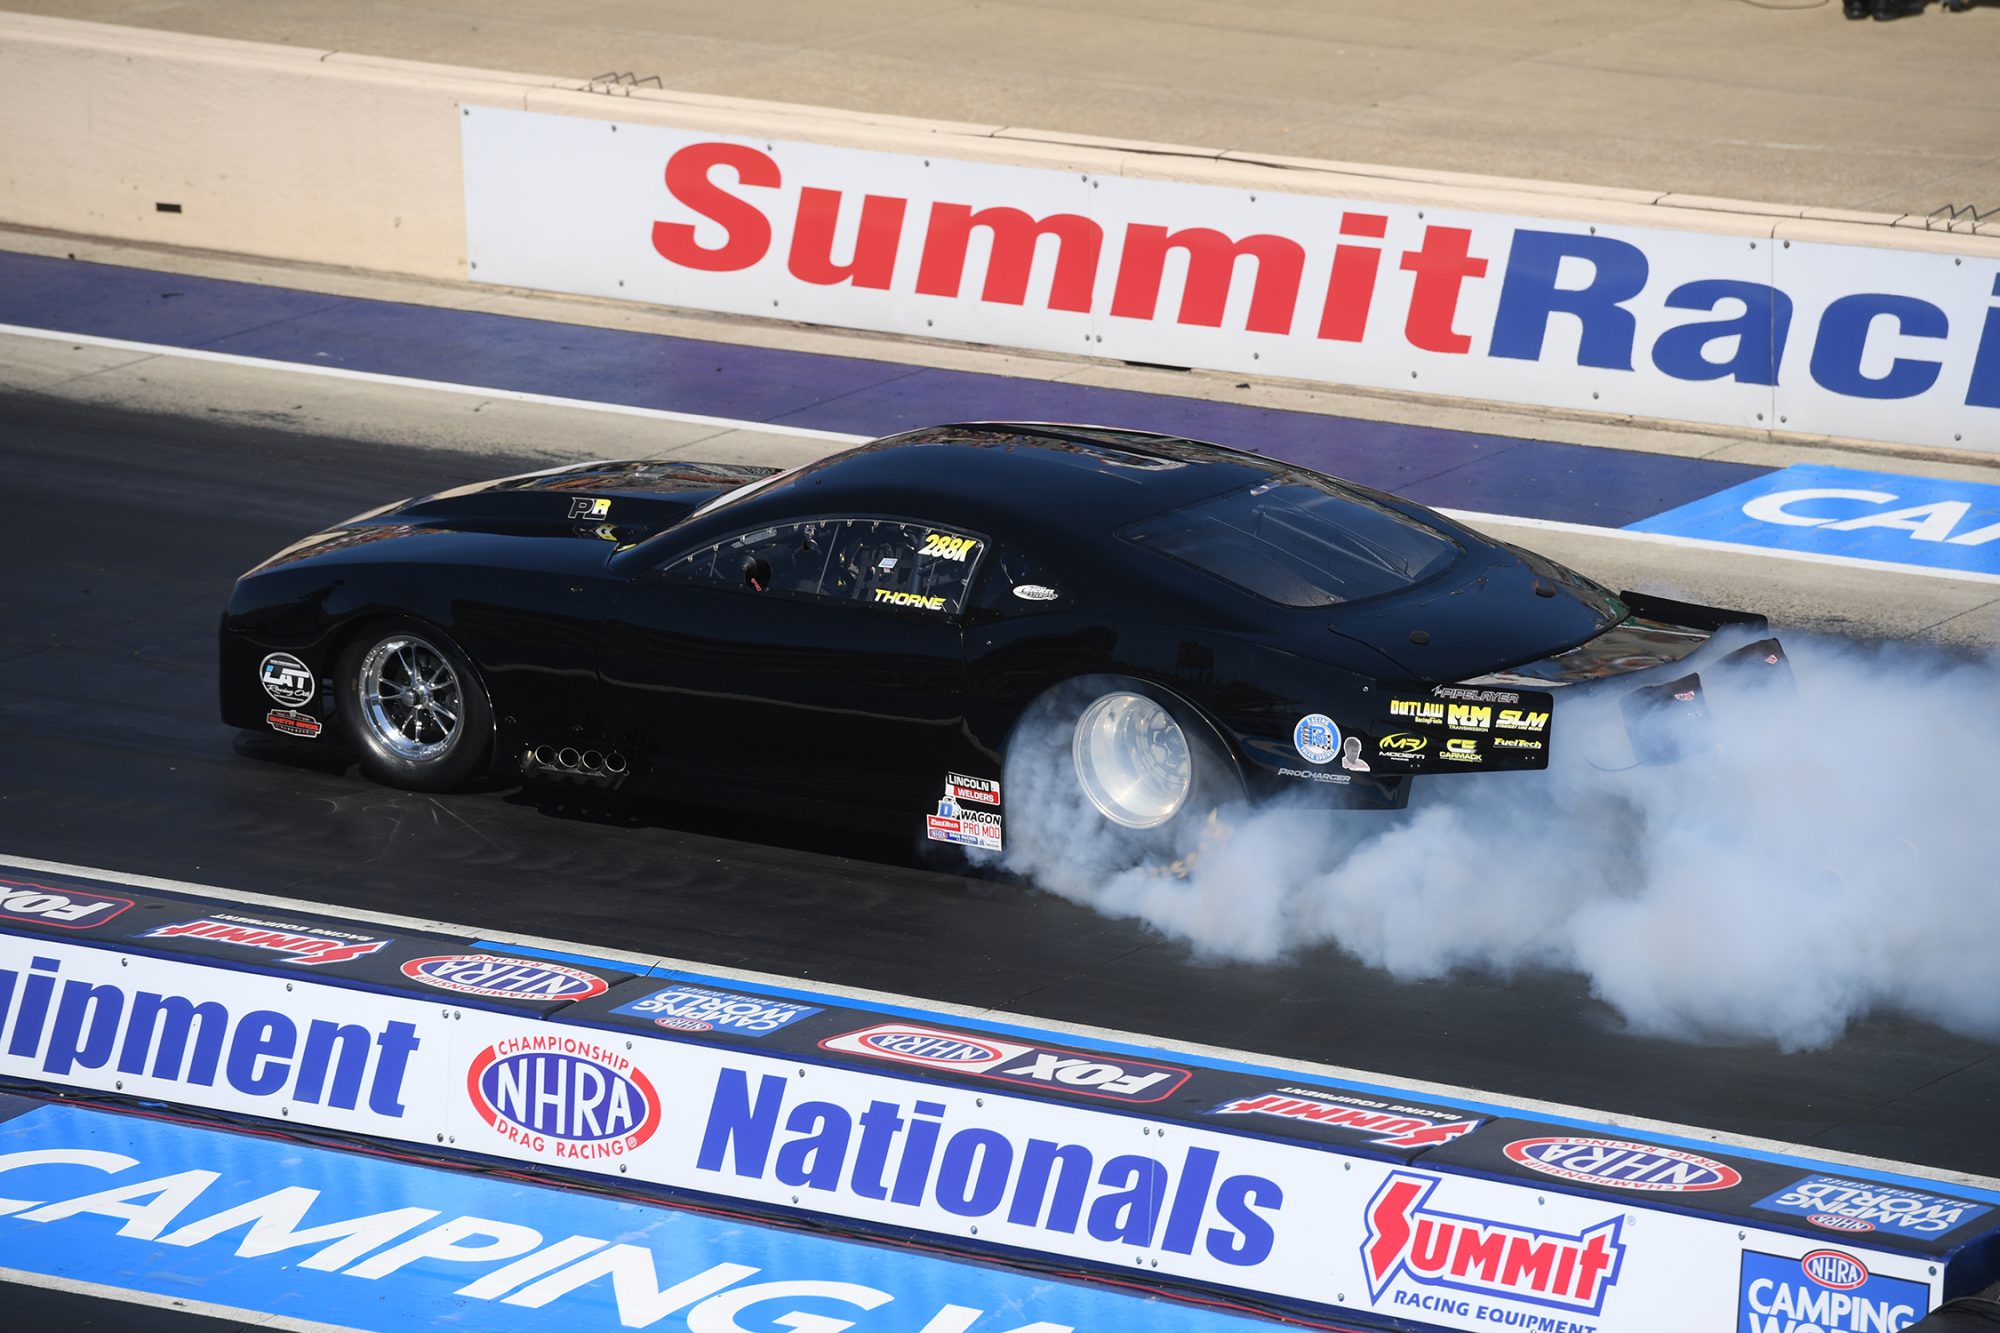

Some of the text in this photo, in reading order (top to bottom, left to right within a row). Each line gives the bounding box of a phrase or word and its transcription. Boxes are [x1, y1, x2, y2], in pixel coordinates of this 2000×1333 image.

[1741, 488, 2000, 546] CA
[918, 534, 977, 562] 288K
[874, 589, 946, 611] THORNE
[263, 665, 310, 690] LAT
[1440, 688, 1520, 704] PIPELAYER
[1390, 700, 1444, 718] OUTLAW
[1495, 710, 1549, 728] SLM
[1449, 724, 1489, 732] TRANSMISSION
[1384, 736, 1543, 753] MR CE FuelTech
[1439, 751, 1482, 761] CARMACK
[948, 774, 989, 791] LINCOLN
[957, 788, 994, 802] WELDERS
[961, 810, 1001, 825] WAGON
[963, 822, 979, 836] PRO
[982, 825, 1001, 839] MOD
[210, 913, 374, 941] RACING EQUIPMENT
[431, 961, 581, 994] NHRA
[469, 954, 593, 980] DRAG RACING
[415, 975, 548, 1000] CHAMPIONSHIP
[632, 1000, 779, 1030] CAMPING
[654, 991, 796, 1023] WORLD
[498, 1036, 629, 1071] CHAMPIONSHIP
[878, 1034, 1171, 1095] FOX NHRA
[496, 1057, 634, 1137] NHRA
[1276, 1086, 1462, 1121] RACING EQUIPMENT
[496, 1119, 624, 1159] DRAG RACING
[1573, 1137, 1721, 1168] DRAG RACING
[696, 1066, 1284, 1268] Nationals
[1525, 1160, 1678, 1191] CHAMPIONSHIP
[1538, 1144, 1707, 1184] NHRA
[1796, 1183, 1964, 1223] WORLD
[1818, 1177, 1979, 1209] DRAG RACING SERIES
[1775, 1193, 1949, 1232] CAMPING
[1816, 1215, 1868, 1231] NHRA
[0, 1148, 895, 1333] CAMPING
[1810, 1256, 1859, 1283] NHRA
[1394, 1290, 1470, 1316] RACING
[1748, 1278, 1915, 1333] CAMPING
